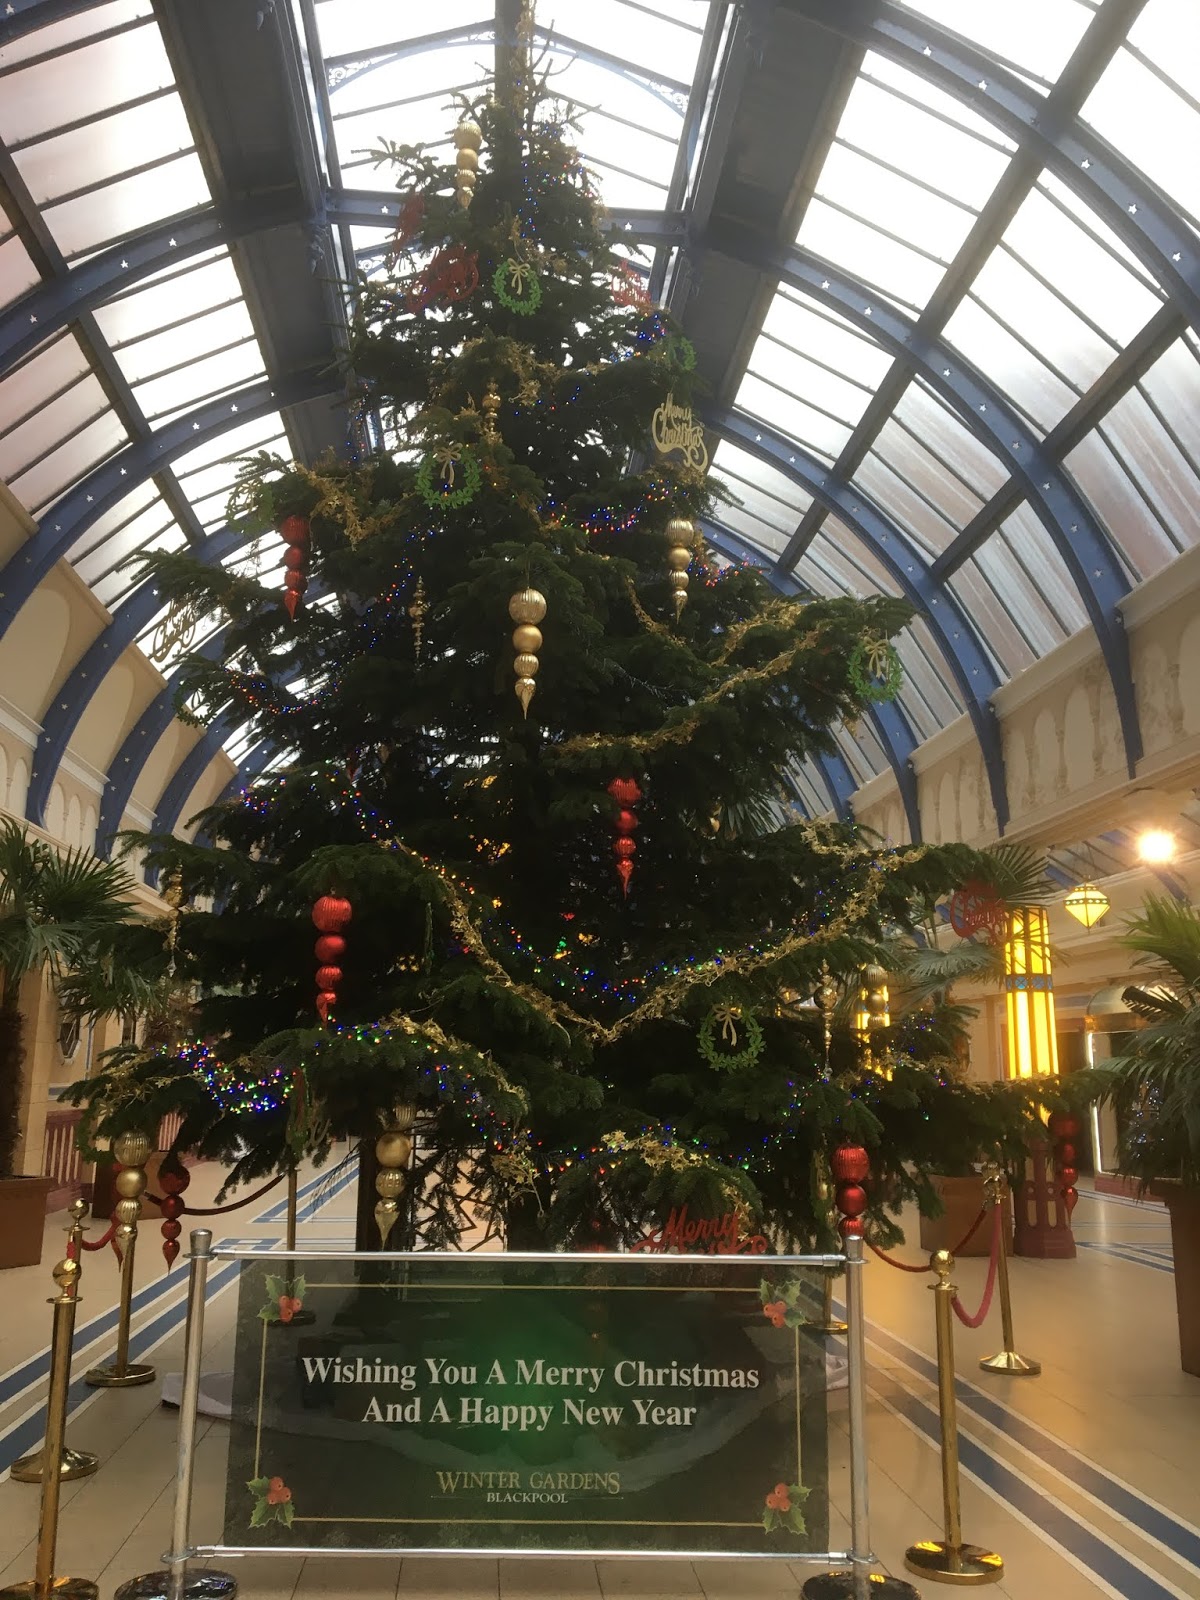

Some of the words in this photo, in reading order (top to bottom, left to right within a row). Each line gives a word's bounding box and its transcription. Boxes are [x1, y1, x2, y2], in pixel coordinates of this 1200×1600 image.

[658, 1203, 739, 1254] Merry
[302, 1357, 417, 1391] Wishing
[425, 1358, 478, 1385] You
[485, 1359, 508, 1385] A
[515, 1359, 606, 1393] Merry
[614, 1360, 760, 1389] Christmas
[361, 1396, 422, 1423] And
[428, 1397, 452, 1424] A
[458, 1397, 554, 1432] Happy
[562, 1398, 624, 1425] New
[632, 1399, 698, 1426] Year
[435, 1471, 521, 1494] WINTER
[529, 1471, 621, 1495] GARDENS
[486, 1492, 569, 1504] BLACKPOOL
